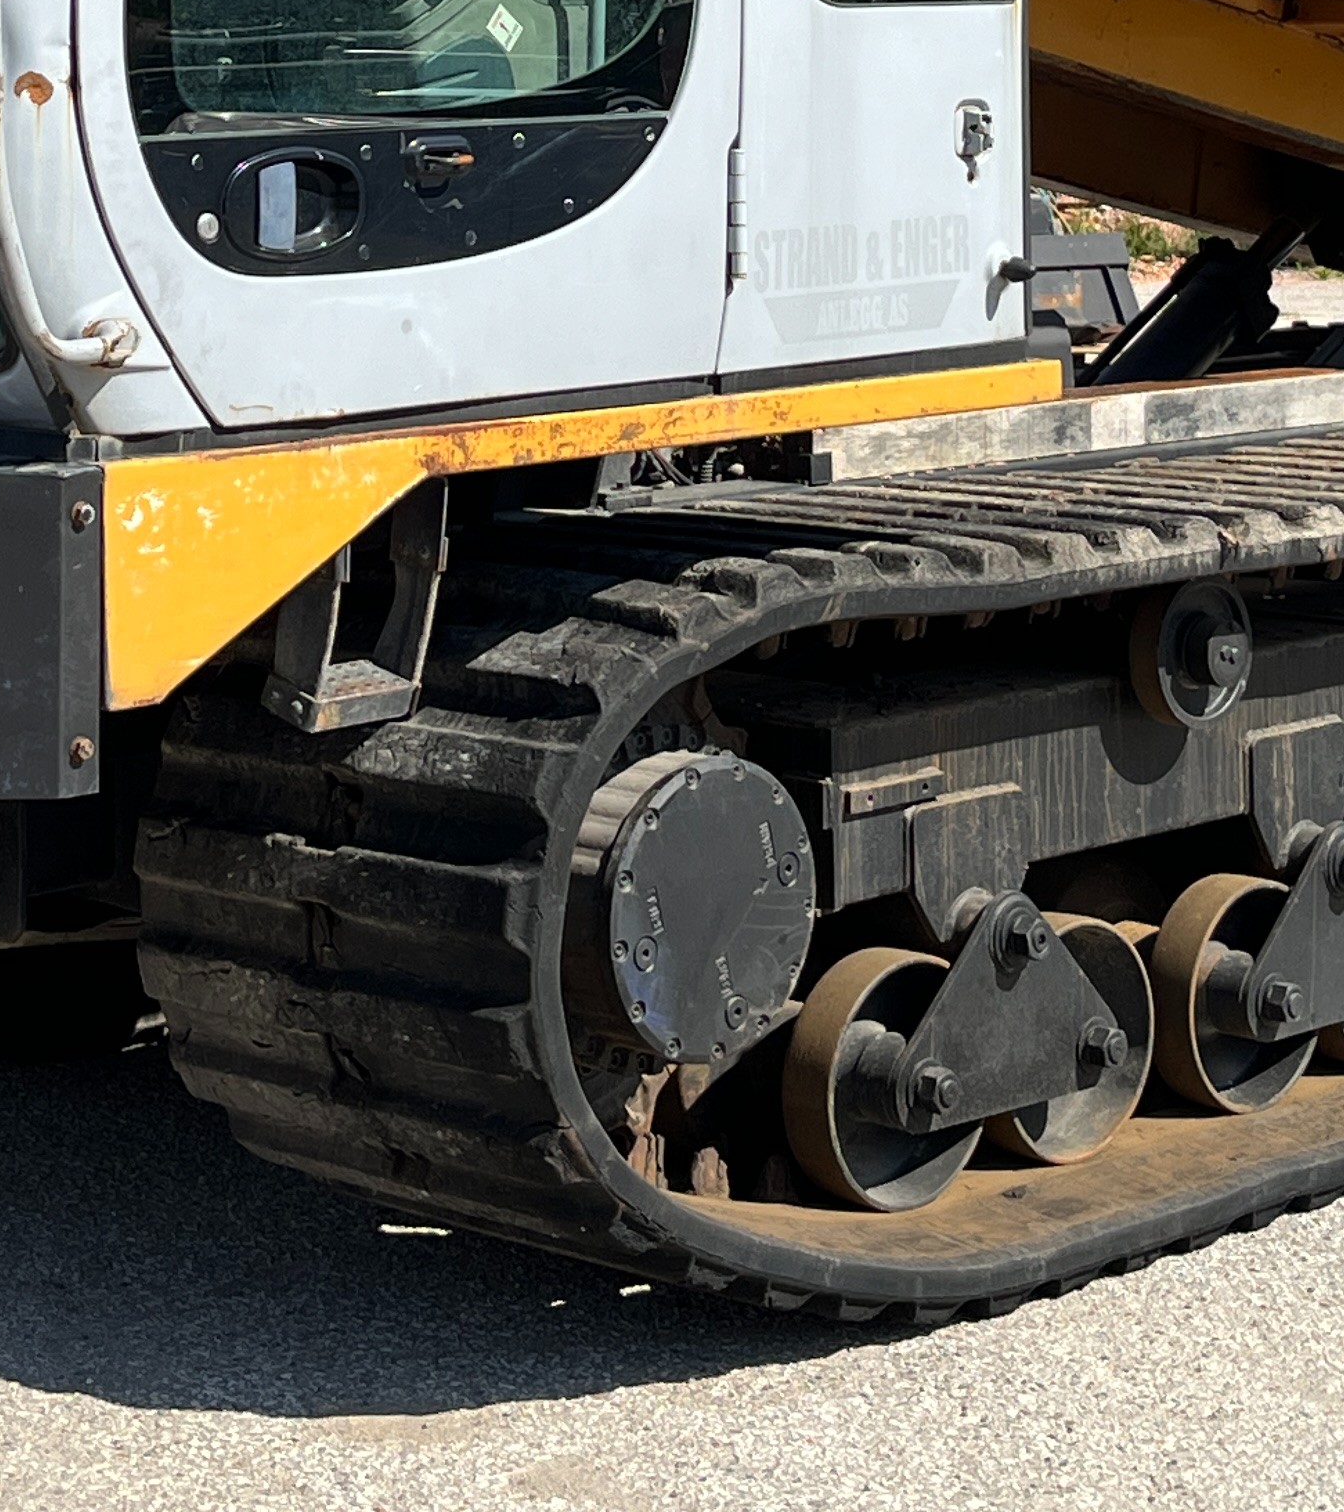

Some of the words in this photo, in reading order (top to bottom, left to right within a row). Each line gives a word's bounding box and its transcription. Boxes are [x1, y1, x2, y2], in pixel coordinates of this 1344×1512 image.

[754, 224, 858, 292] STRAND
[865, 231, 884, 281] &
[891, 215, 970, 278] ENGER
[818, 295, 884, 329] ANLEGG
[888, 293, 910, 327] AS
